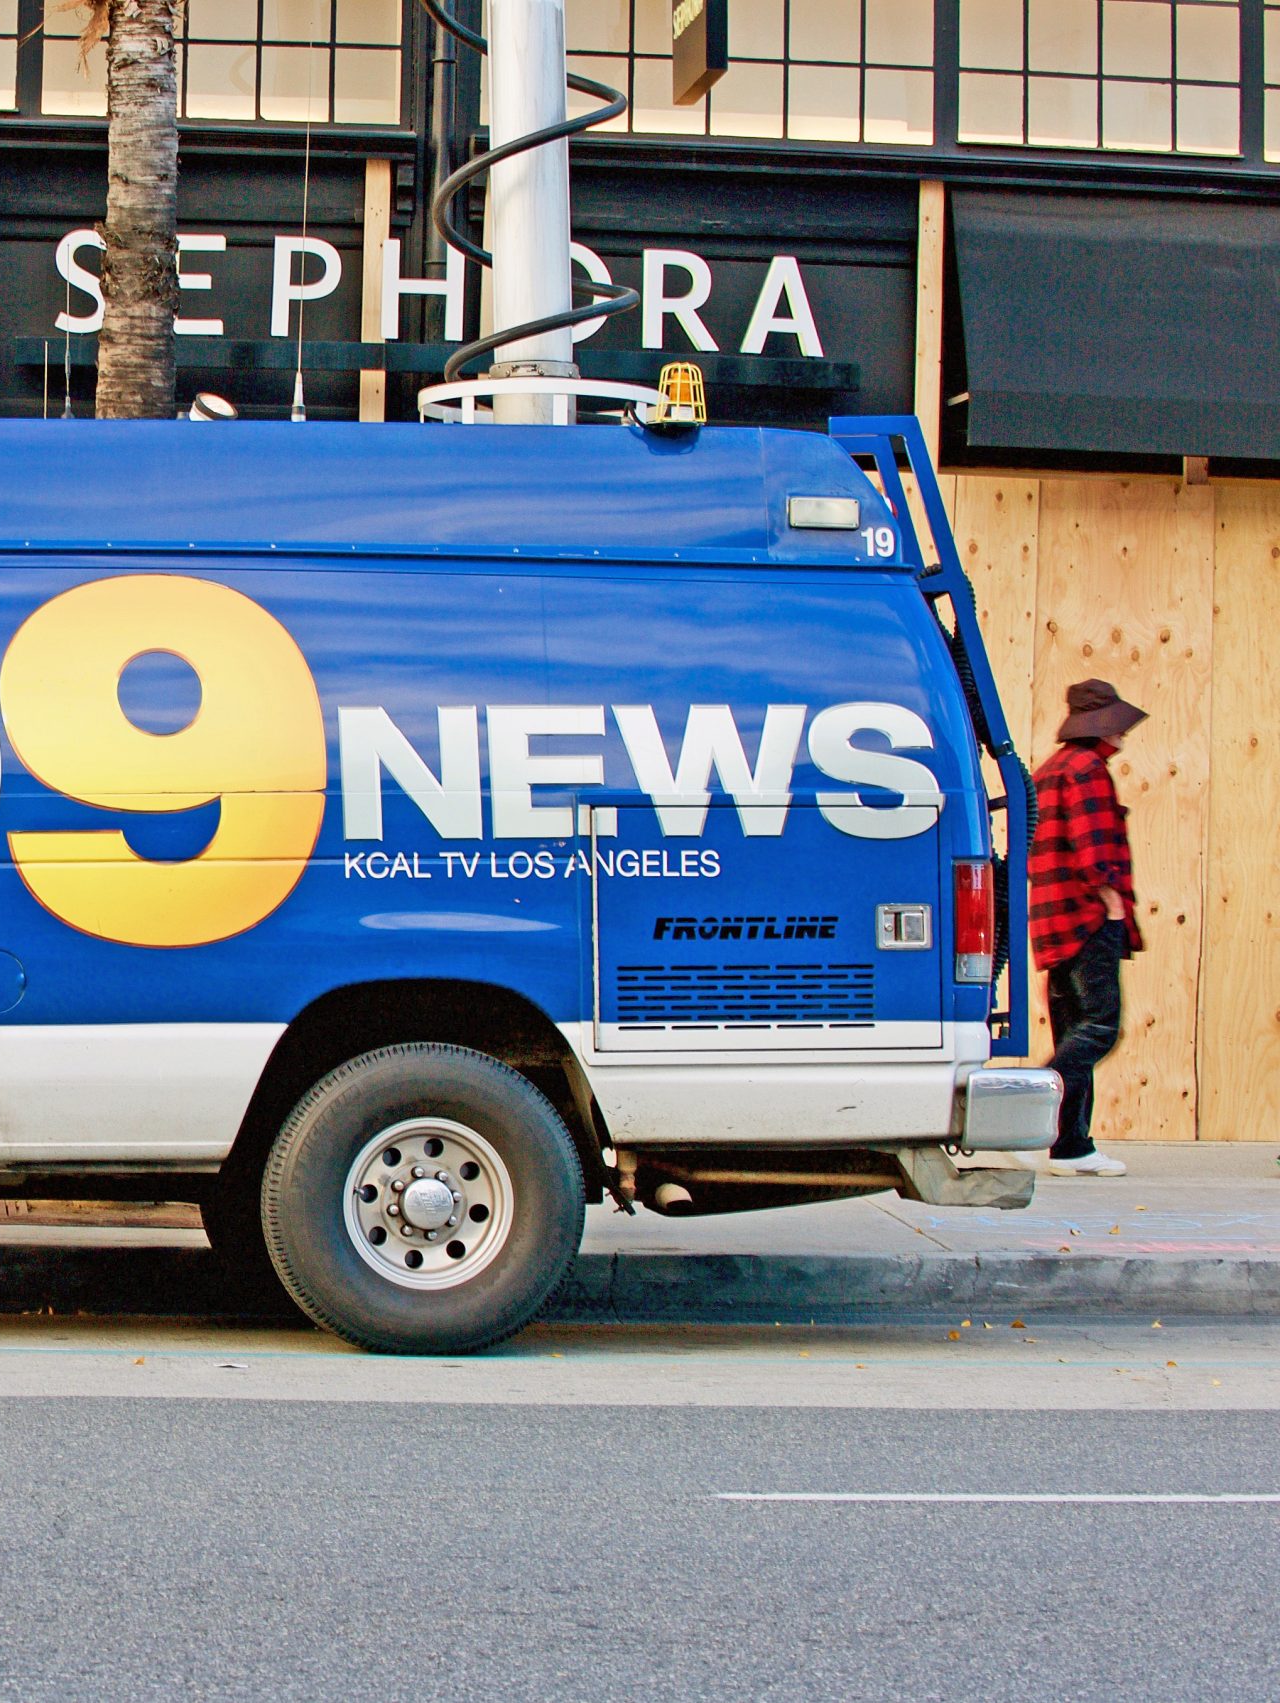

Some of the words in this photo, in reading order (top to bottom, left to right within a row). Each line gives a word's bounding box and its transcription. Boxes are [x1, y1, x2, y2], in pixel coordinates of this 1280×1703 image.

[860, 526, 895, 558] 19
[0, 573, 328, 949] 9
[337, 701, 946, 841] NEWS
[344, 851, 431, 879] KCAL
[440, 851, 481, 879] TV
[491, 850, 556, 879] LOS
[564, 848, 721, 879] ANGELES
[652, 906, 839, 940] FRONTLINE
